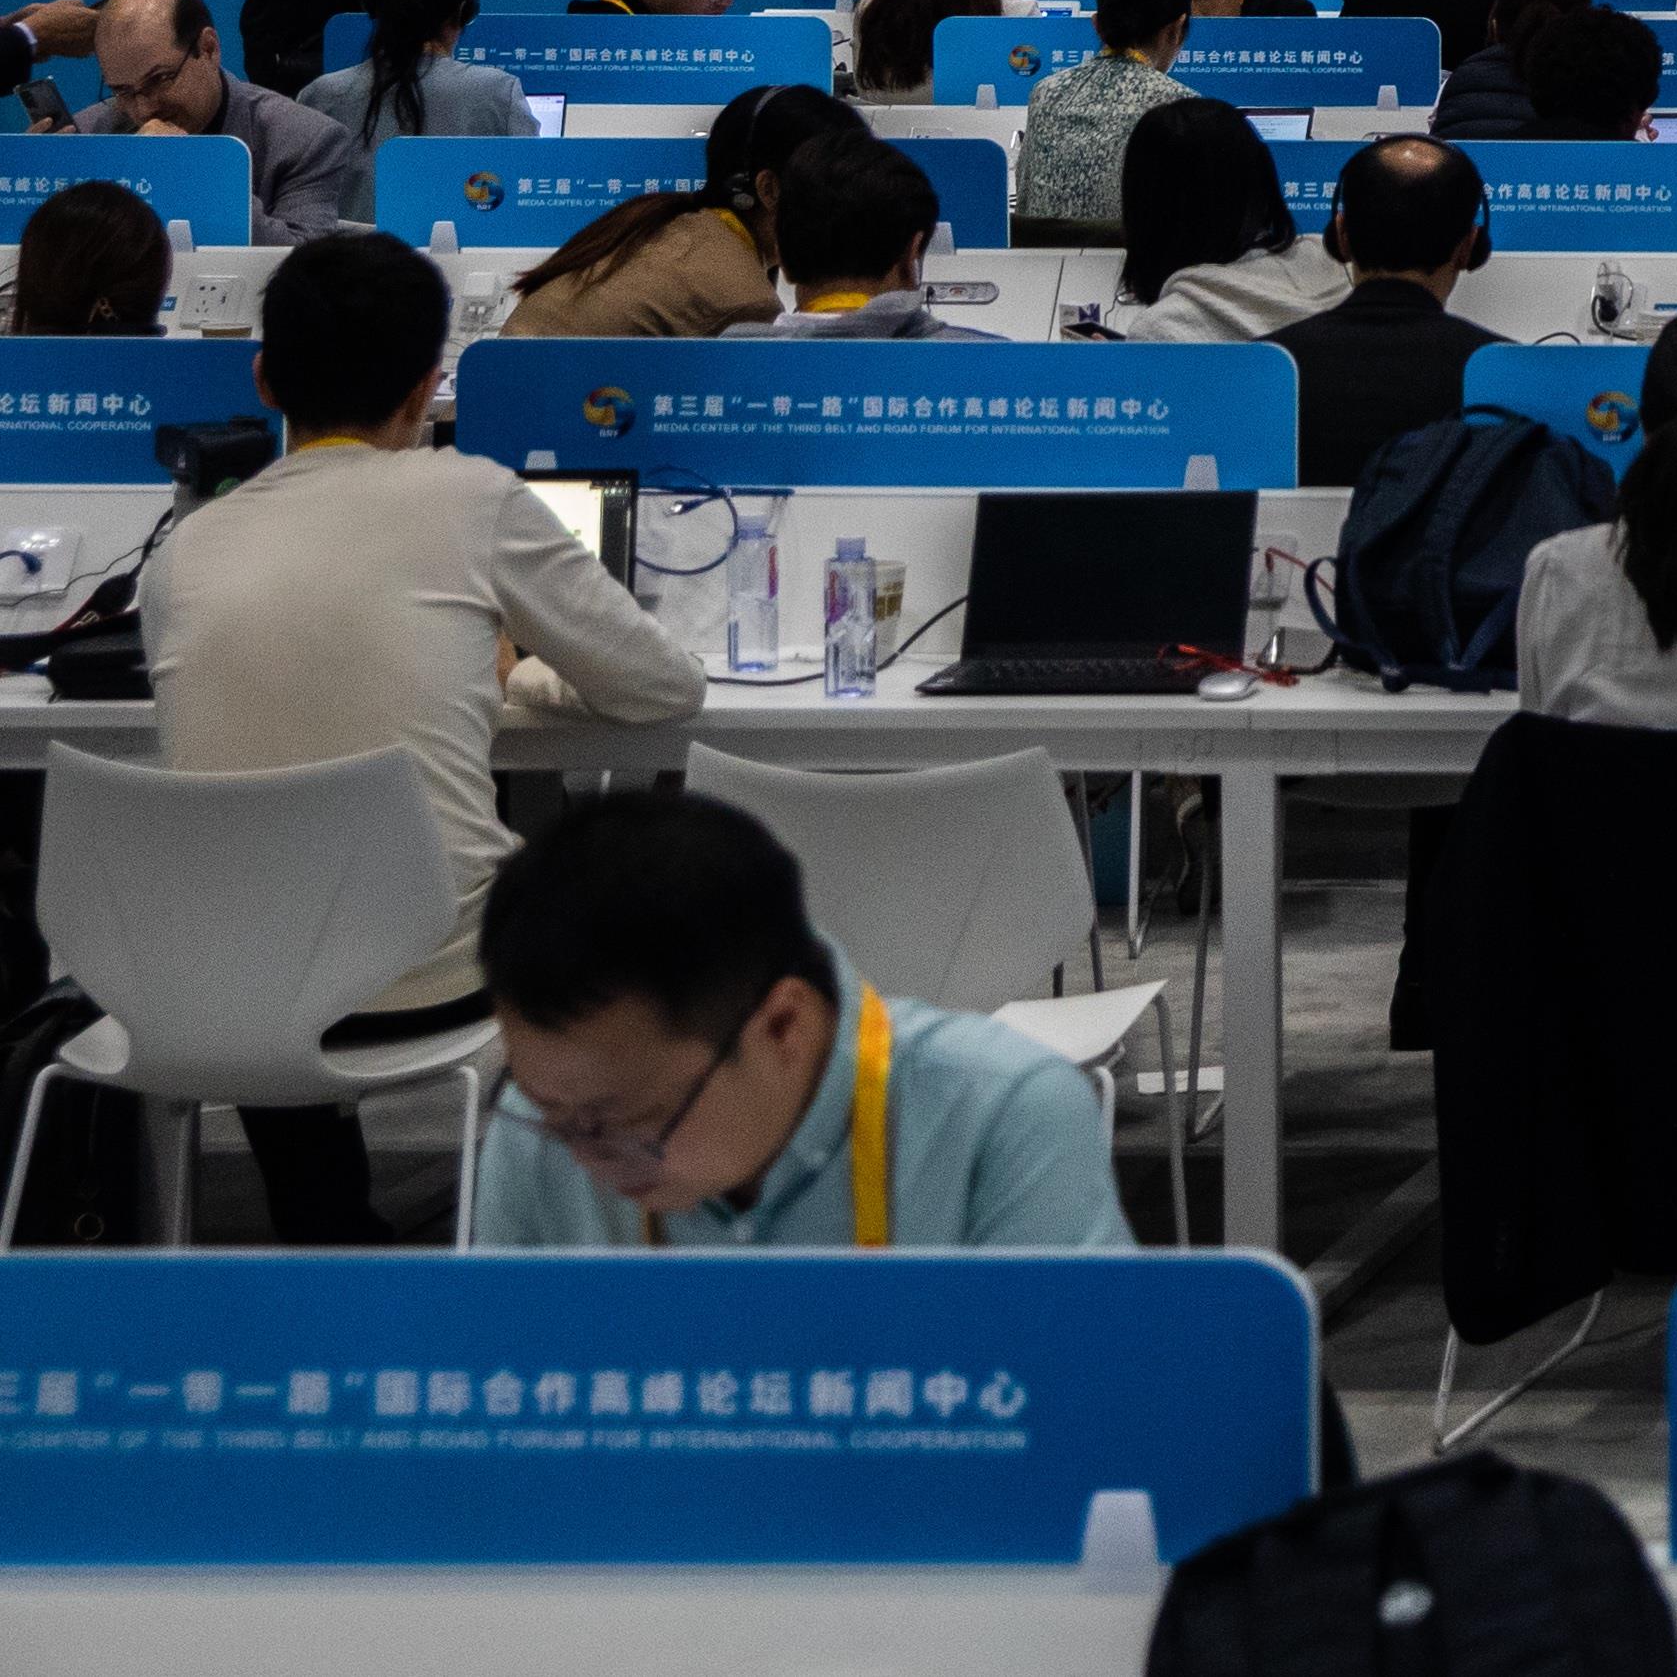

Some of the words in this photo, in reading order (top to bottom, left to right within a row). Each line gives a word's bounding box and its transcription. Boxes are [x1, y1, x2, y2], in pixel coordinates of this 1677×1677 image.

[66, 420, 152, 431] COOPERATION
[654, 422, 691, 433] MEDIA
[692, 422, 740, 433] CENTER
[763, 423, 786, 433] THE
[789, 423, 823, 433] THIRD
[825, 423, 855, 434] BELT
[855, 424, 883, 434] AND
[883, 424, 919, 434] ROAD
[920, 424, 962, 434] FORUM
[965, 424, 989, 434] FOR
[991, 424, 1082, 435] INTERNATIONAL
[1085, 425, 1170, 435] COOPERATION
